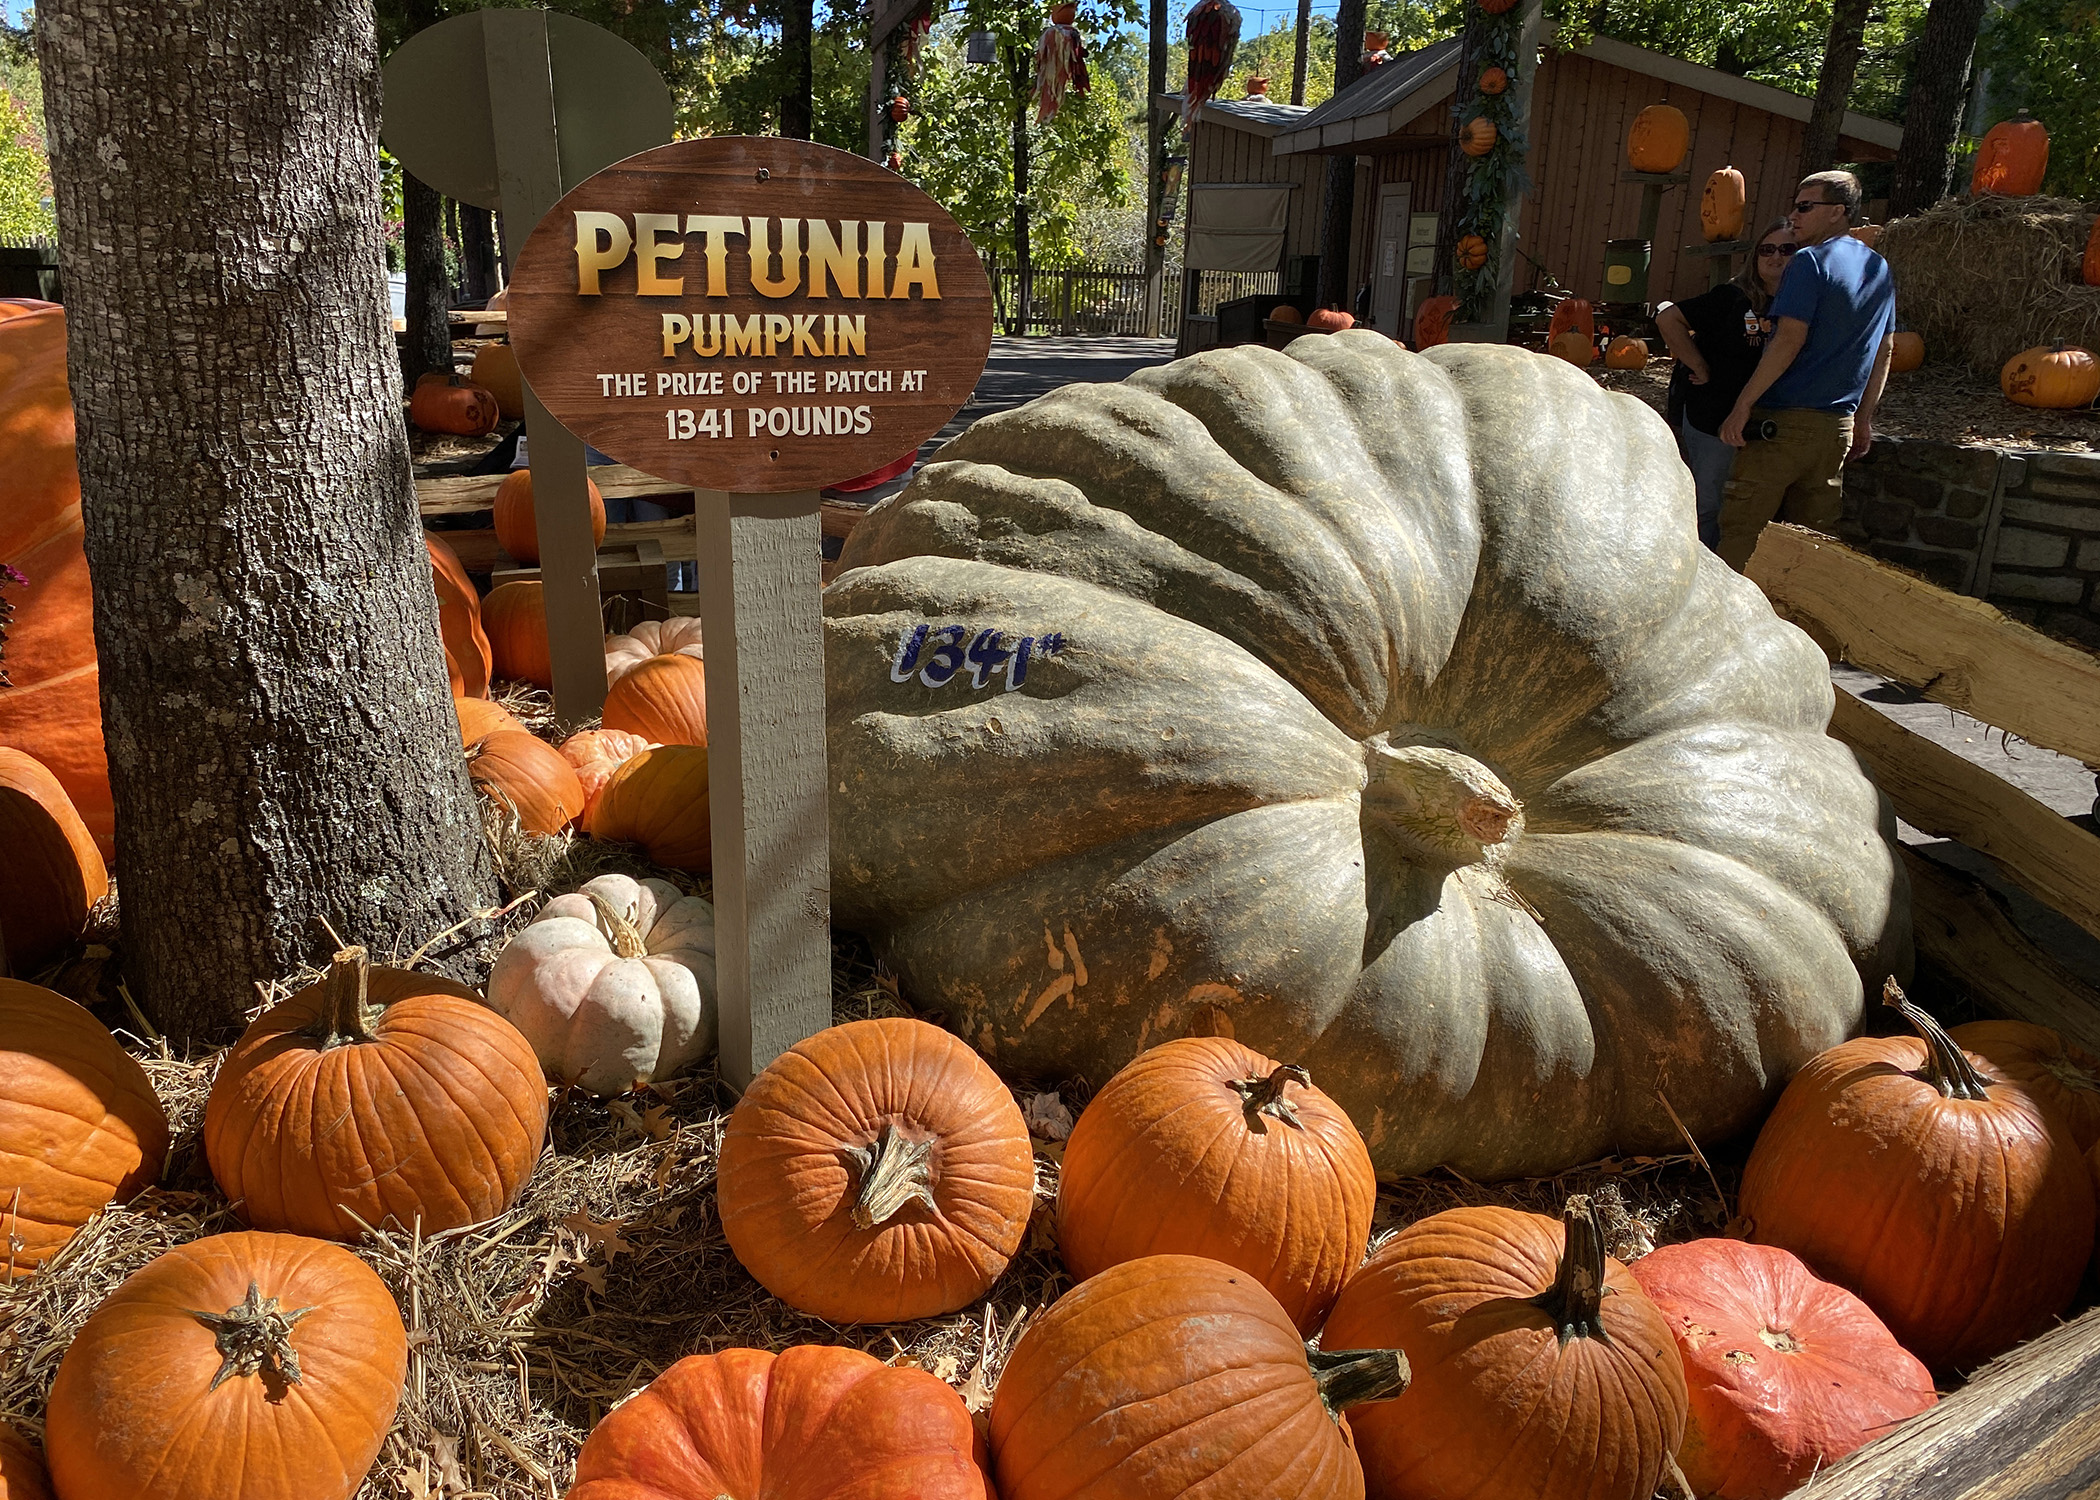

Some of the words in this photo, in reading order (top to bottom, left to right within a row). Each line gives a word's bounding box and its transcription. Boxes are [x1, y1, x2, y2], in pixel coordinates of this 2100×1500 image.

[573, 210, 942, 300] PETUNIA
[661, 313, 867, 358] PUMPKIN
[596, 373, 648, 398] THE
[656, 371, 724, 396] PRIZE
[732, 371, 763, 395] OF
[770, 370, 816, 394] THE
[825, 369, 893, 393] PATCH
[900, 369, 928, 392] AT
[665, 408, 734, 441] 1341
[748, 405, 873, 438] POUNDS
